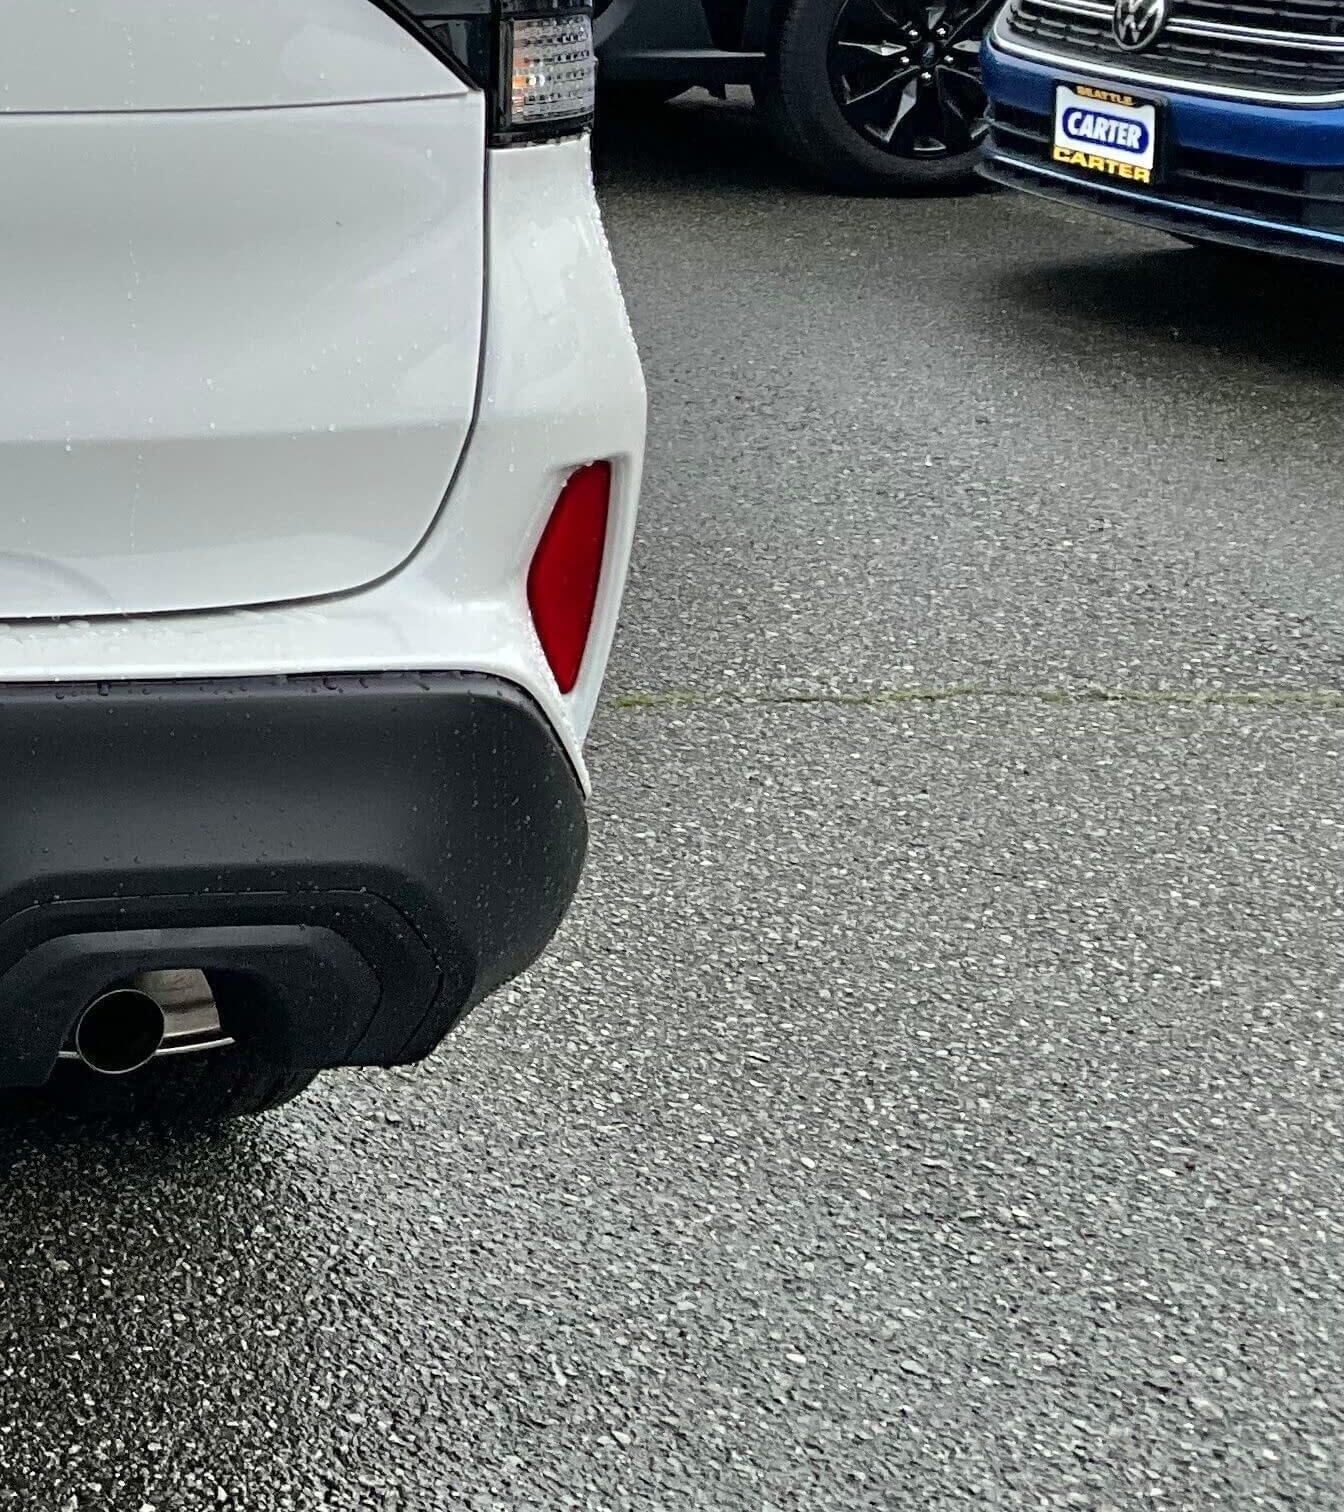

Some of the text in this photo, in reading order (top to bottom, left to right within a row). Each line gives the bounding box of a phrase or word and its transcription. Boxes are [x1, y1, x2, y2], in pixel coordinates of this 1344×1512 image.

[1076, 85, 1135, 107] SEATTLE
[1066, 110, 1142, 150] CARTER
[1052, 145, 1151, 184] CARTER
